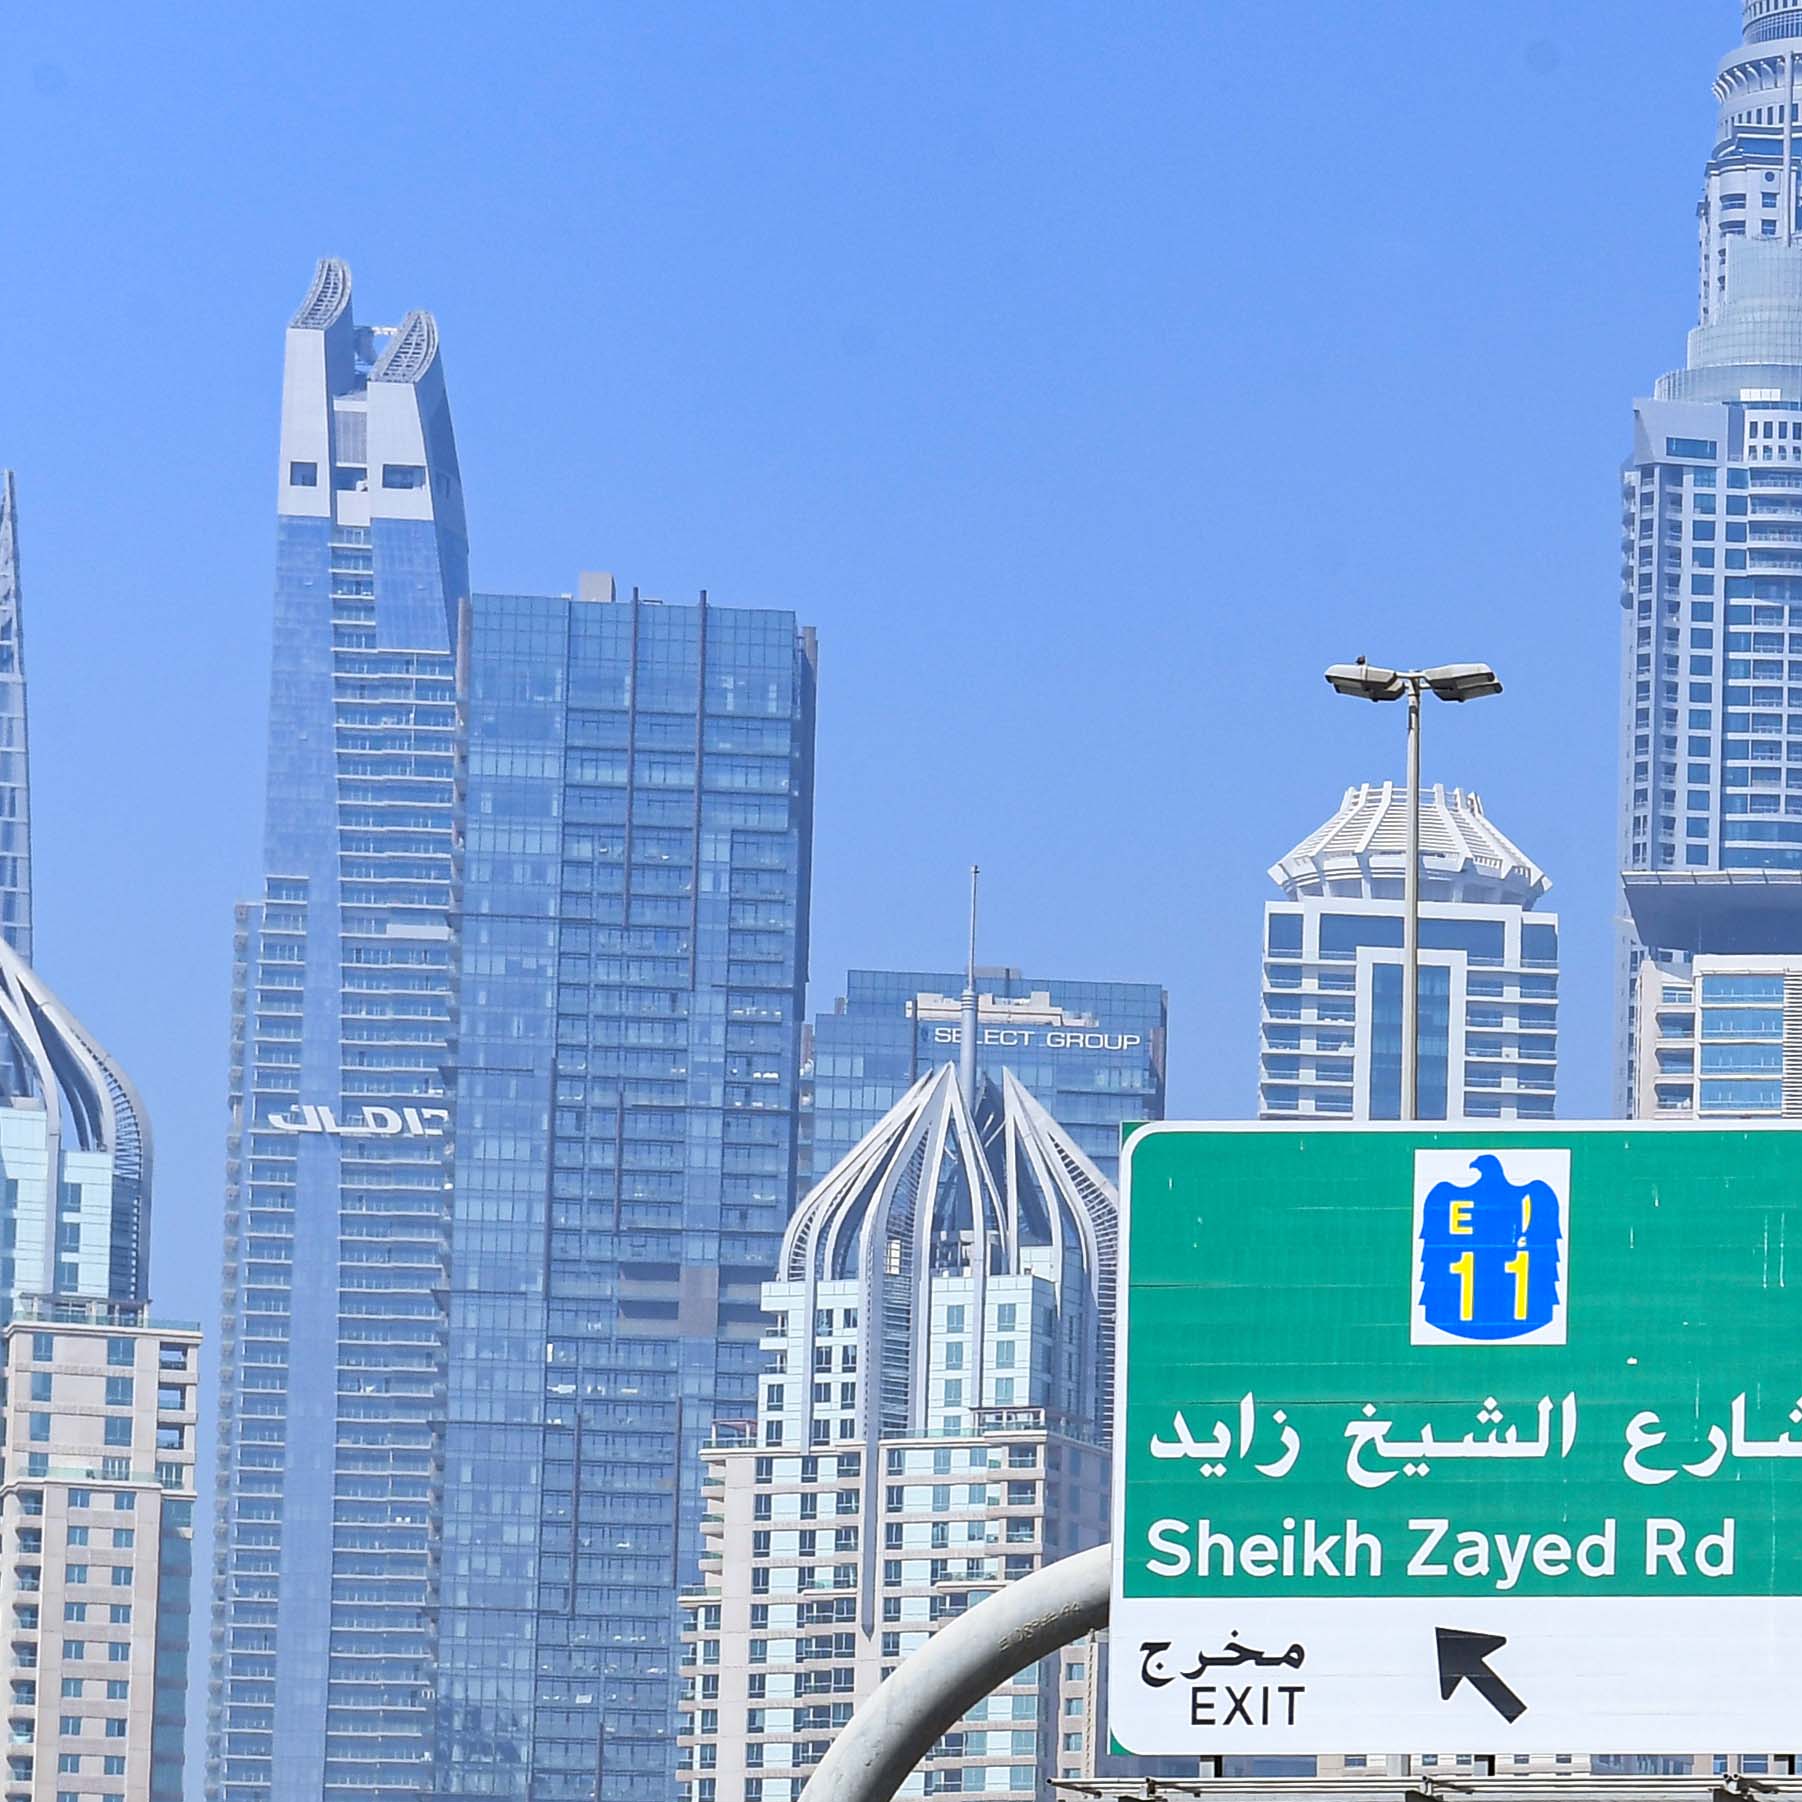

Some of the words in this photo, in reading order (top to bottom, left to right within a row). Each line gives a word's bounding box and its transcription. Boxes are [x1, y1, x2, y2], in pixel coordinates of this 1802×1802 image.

[1046, 1032, 1140, 1051] GROUP
[1450, 1201, 1472, 1234] E
[1150, 1392, 1300, 1477] زايد
[1345, 1392, 1577, 1487] الشيخ
[1147, 1518, 1382, 1577] Sheikh
[1408, 1518, 1616, 1590] Zayed
[1646, 1518, 1735, 1577] Rd
[1139, 1629, 1305, 1687] مخرج
[1191, 1686, 1305, 1726] EXIT
